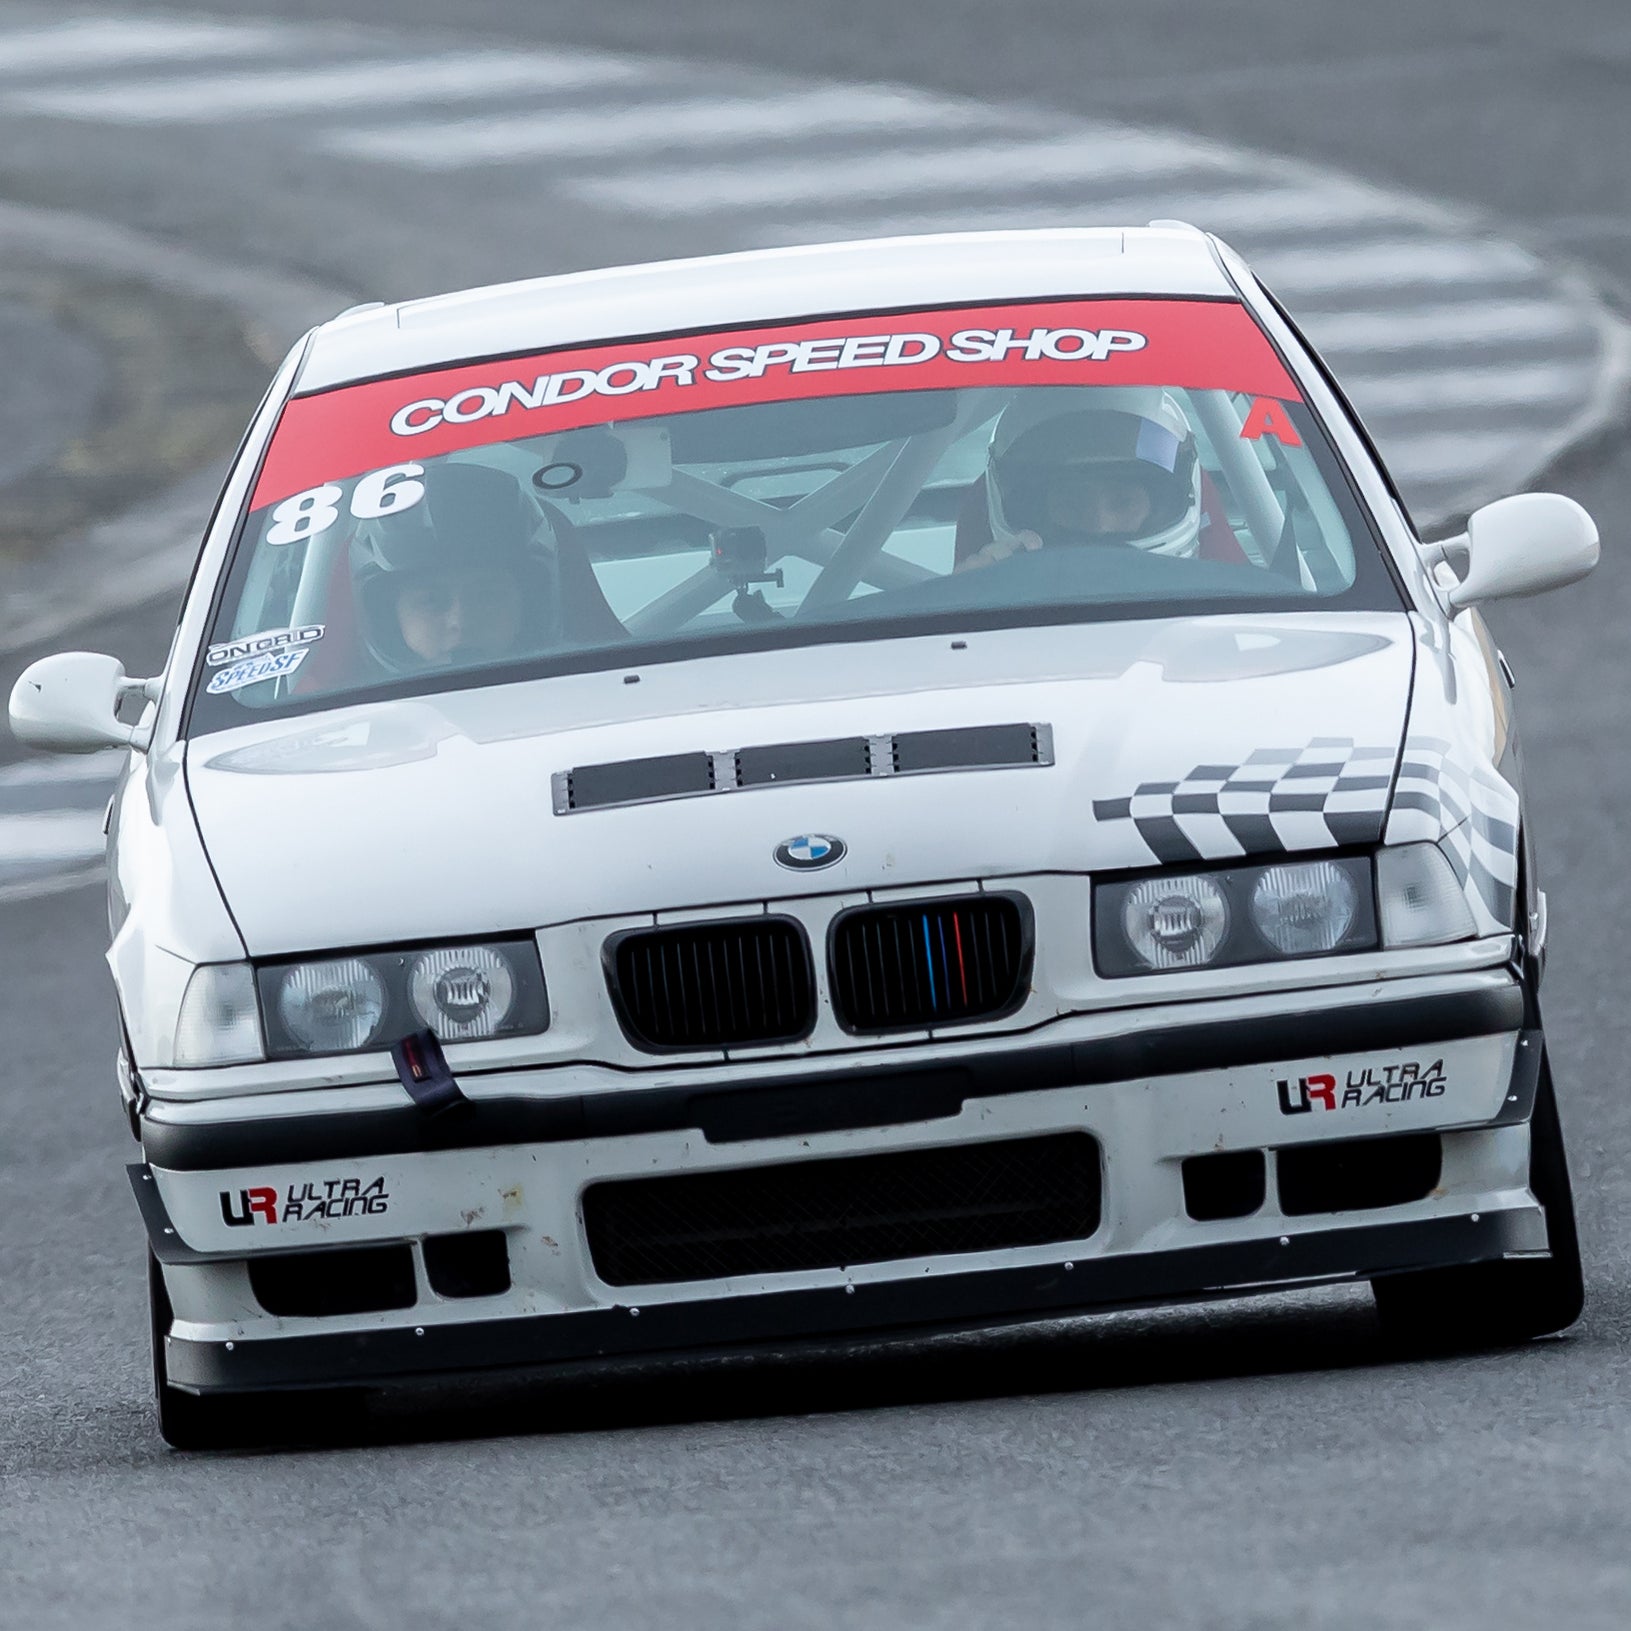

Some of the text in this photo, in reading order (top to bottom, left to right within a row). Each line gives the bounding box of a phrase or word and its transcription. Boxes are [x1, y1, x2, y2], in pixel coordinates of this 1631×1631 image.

[389, 328, 1148, 436] CONDOR SPEED SHOP
[1240, 396, 1303, 448] A
[266, 464, 425, 545] 86
[1276, 1073, 1336, 1116] UR
[1341, 1076, 1447, 1109] RACING
[1346, 1059, 1444, 1089] ULTRA
[219, 1186, 278, 1227] UR
[282, 1193, 390, 1223] RACING
[287, 1176, 385, 1203] ULTRA
